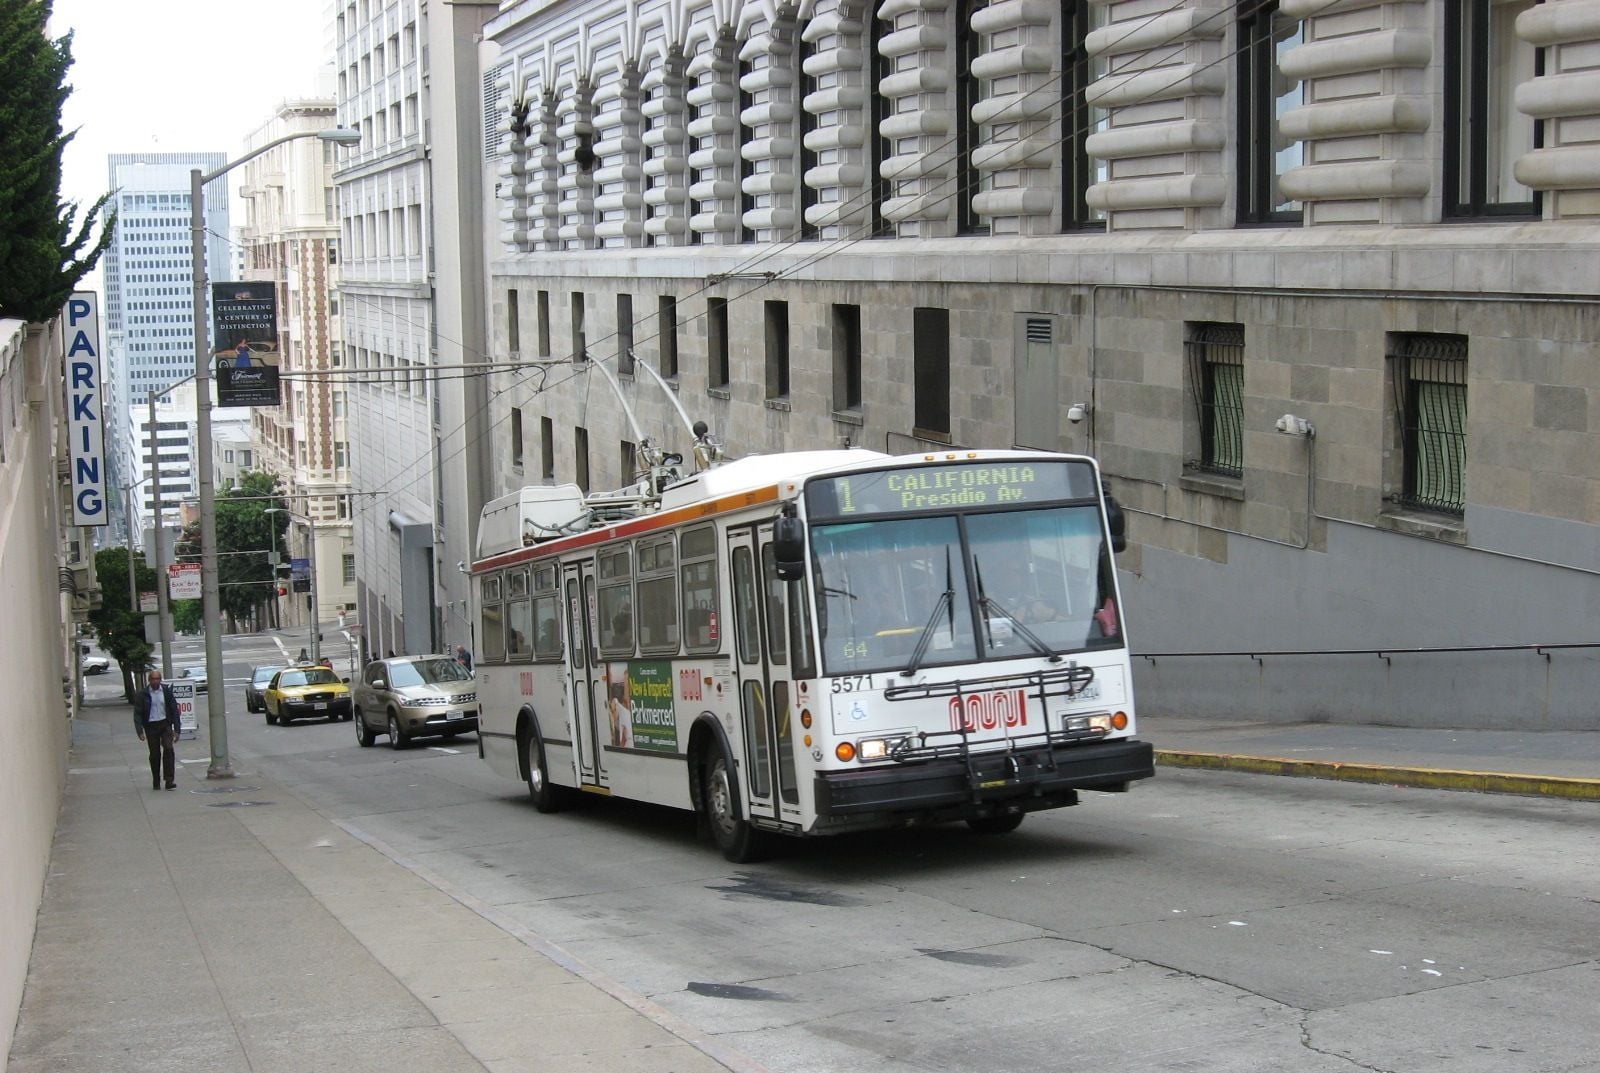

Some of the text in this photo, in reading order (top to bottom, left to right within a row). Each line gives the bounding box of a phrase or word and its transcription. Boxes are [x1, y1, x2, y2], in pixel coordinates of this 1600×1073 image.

[68, 299, 103, 516] PARKING
[840, 465, 1035, 512] 1 CALIFORNIA
[901, 484, 1028, 509] Presidio Av.
[843, 640, 868, 659] 64
[629, 677, 642, 697] New
[648, 677, 672, 702] Inspired!
[831, 674, 873, 694] 5571
[631, 699, 675, 726] Parkmerced
